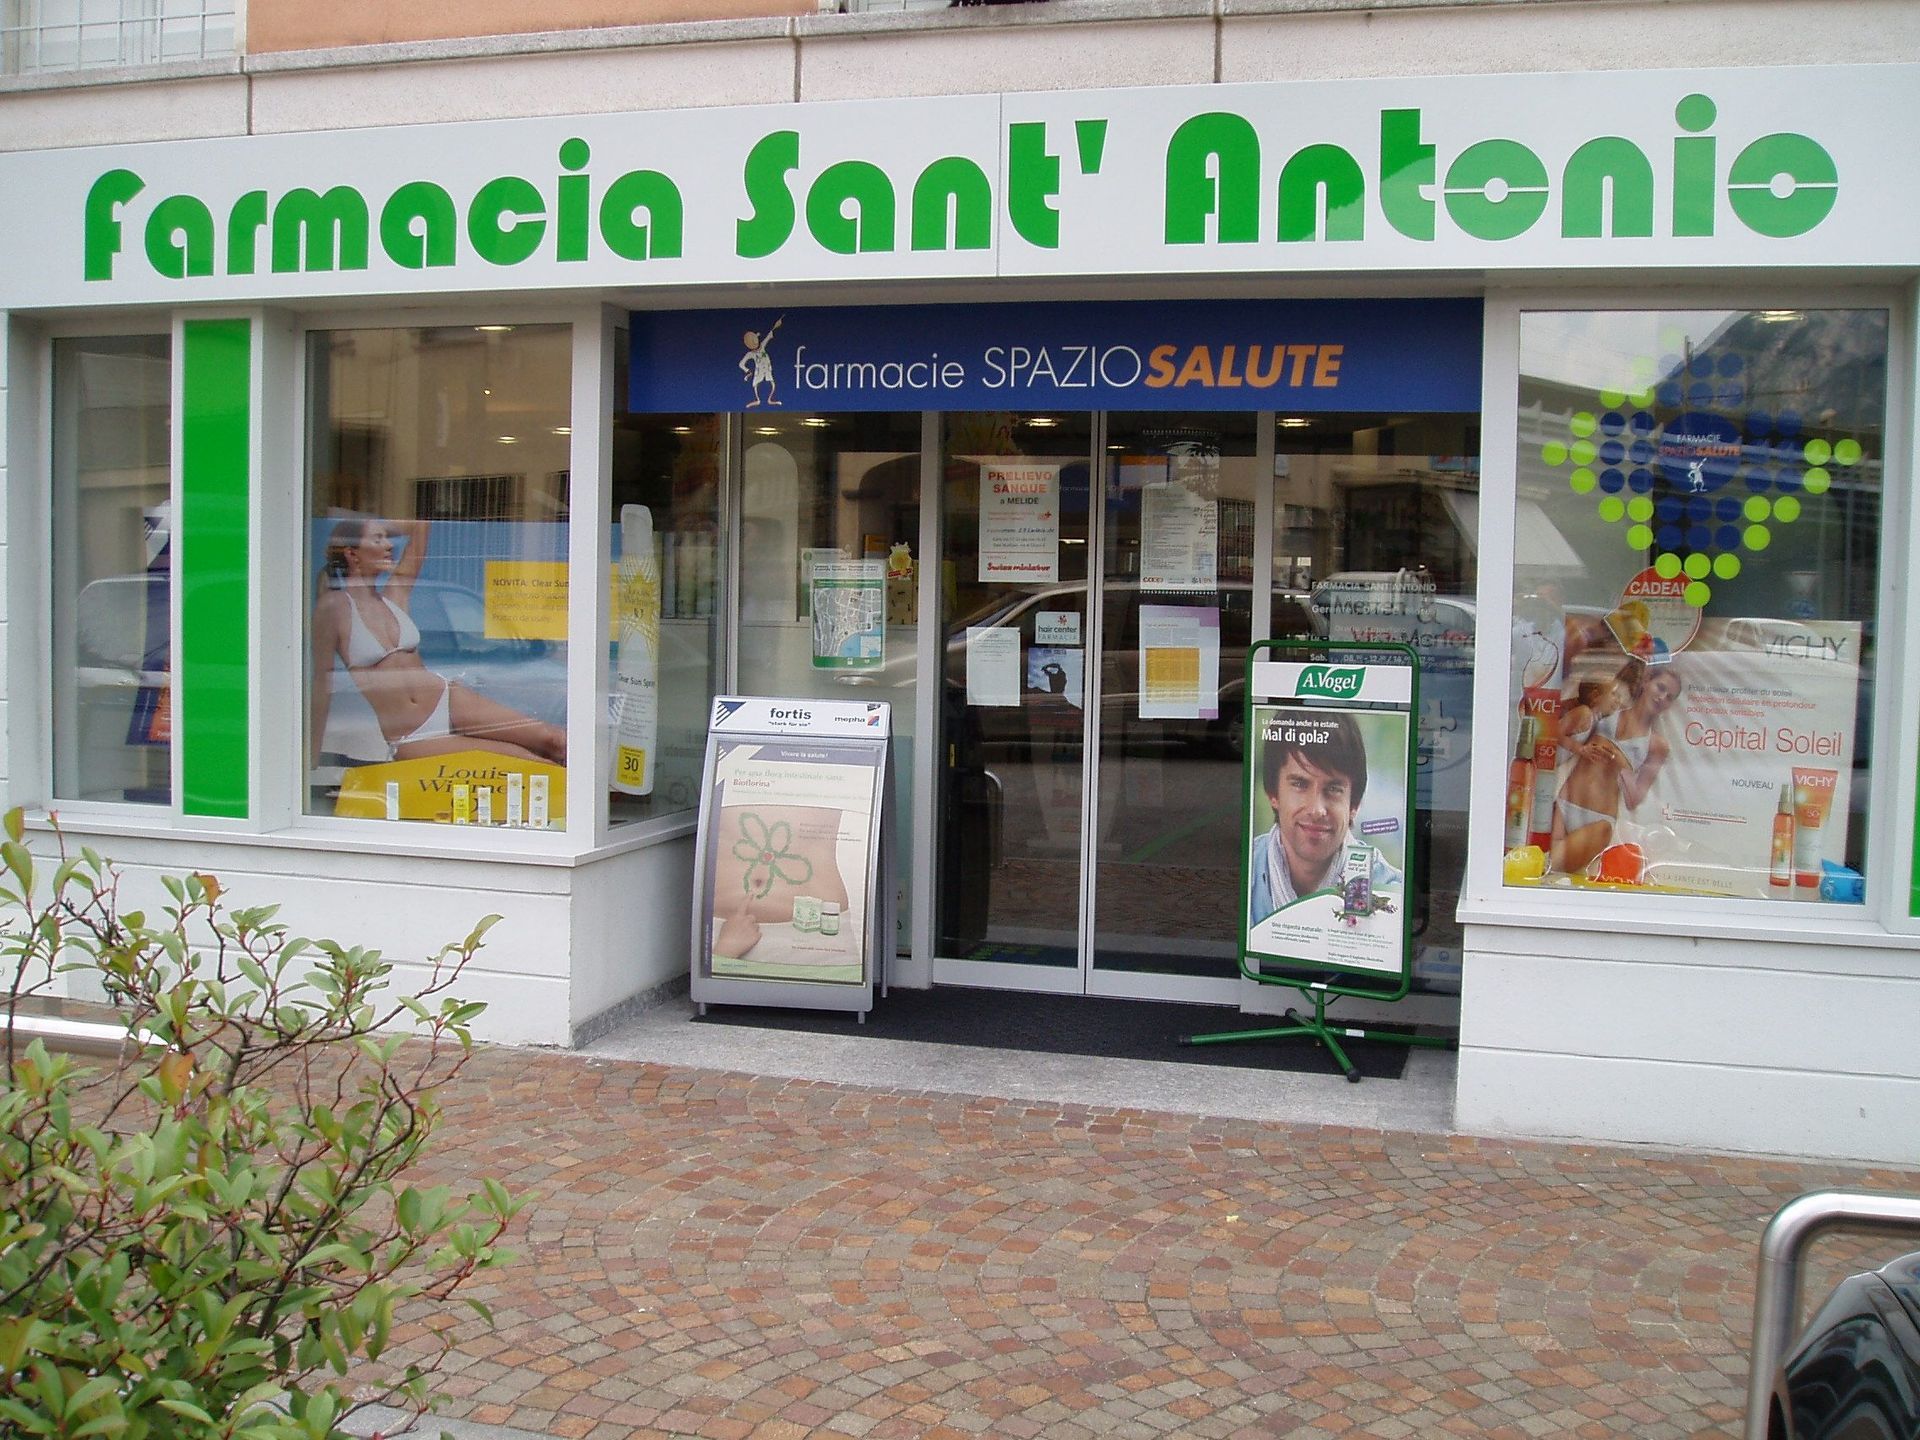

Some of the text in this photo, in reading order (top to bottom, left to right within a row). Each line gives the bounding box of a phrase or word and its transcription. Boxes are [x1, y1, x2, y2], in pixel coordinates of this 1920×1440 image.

[736, 118, 1108, 259] Sant'
[1164, 93, 1838, 244] Antonio
[794, 345, 964, 389] farmacie
[988, 471, 1052, 481] PRELIEVO
[993, 484, 1047, 493] SANGUE
[1007, 497, 1039, 505] MELIDE
[1302, 672, 1357, 692] A.Vogel
[770, 708, 812, 720] fortis
[1262, 728, 1329, 746] Mal di gola?
[1685, 721, 1842, 756] Capital Soleil
[624, 756, 639, 772] 30
[437, 765, 509, 779] Louis
[1732, 779, 1774, 790] NOUVEAU
[1795, 774, 1834, 787] VICHY
